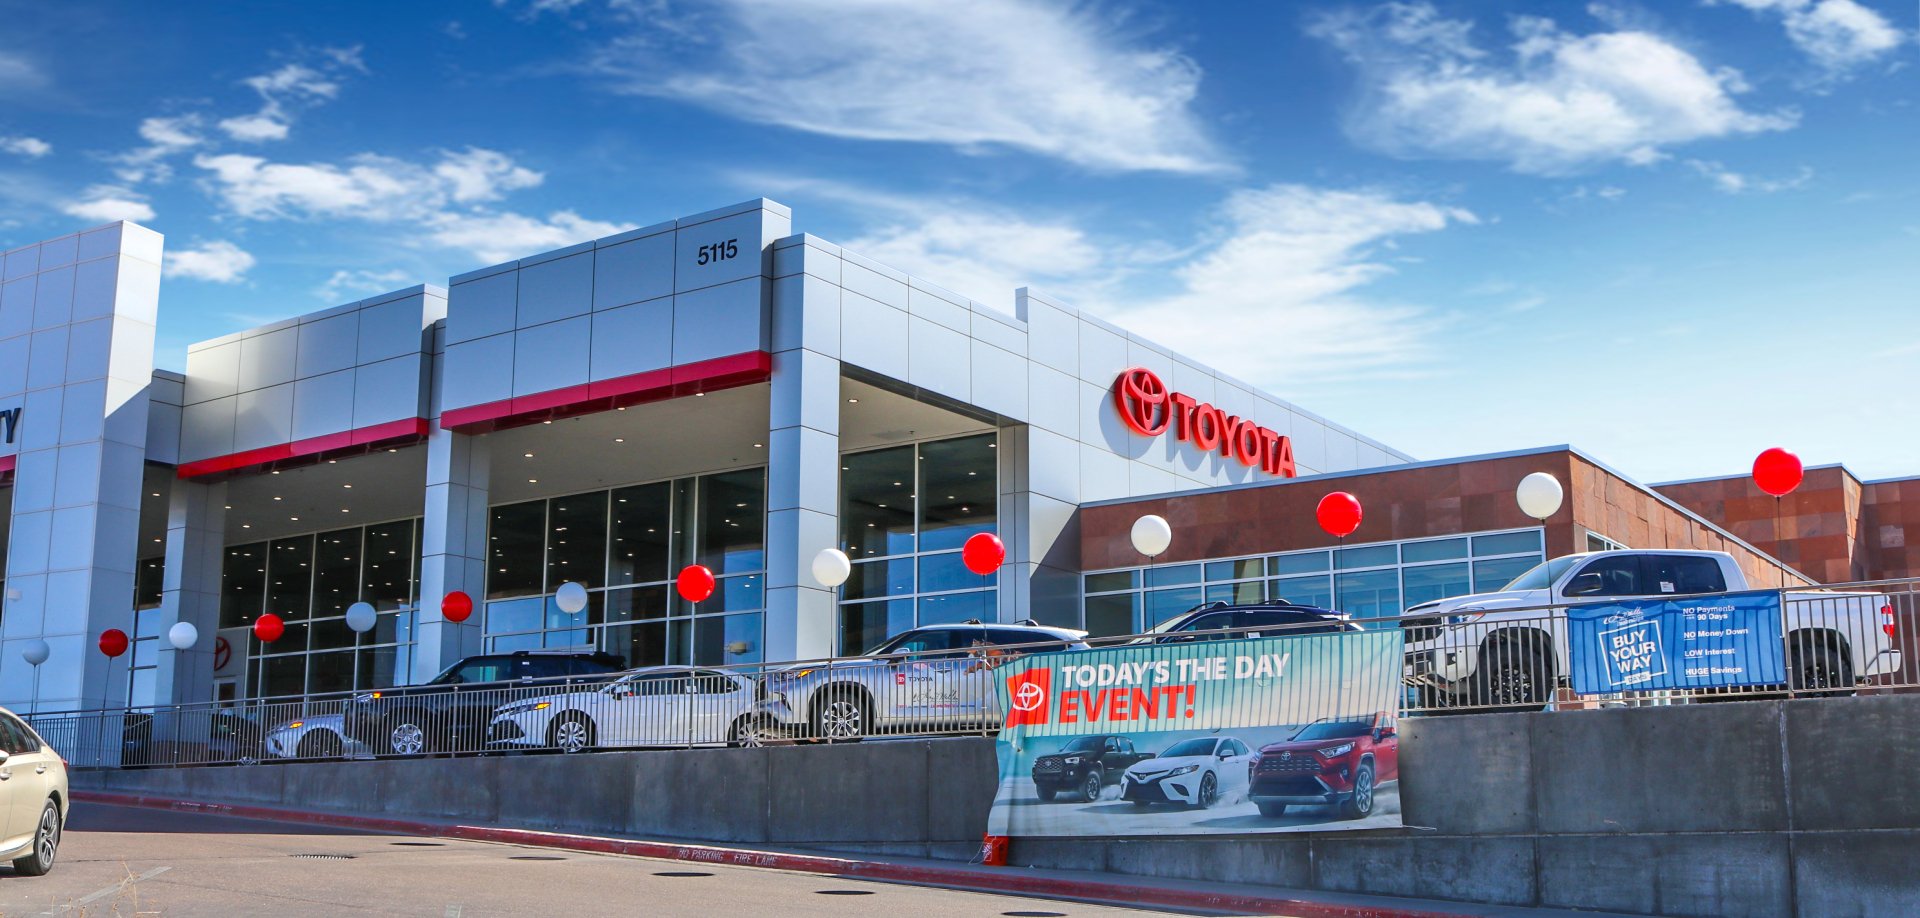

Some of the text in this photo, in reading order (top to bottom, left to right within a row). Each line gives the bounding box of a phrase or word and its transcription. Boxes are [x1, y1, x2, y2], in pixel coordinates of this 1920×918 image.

[697, 238, 738, 266] 5115
[1170, 391, 1297, 479] TOYOTA
[1682, 605, 1736, 615] NO Payments
[1709, 613, 1729, 621] Days
[1612, 629, 1646, 649] BUY
[1684, 628, 1749, 639] NO Money Down
[1609, 641, 1657, 662] YOUR
[1684, 648, 1736, 657] LOW Interest
[1061, 653, 1291, 689] TODAY'S THE DAY
[1617, 654, 1652, 674] WAY
[1685, 666, 1743, 675] HUGE Savings
[1058, 684, 1197, 724] EVENT!
[690, 849, 725, 861] PARKING
[734, 853, 754, 863] FIRE
